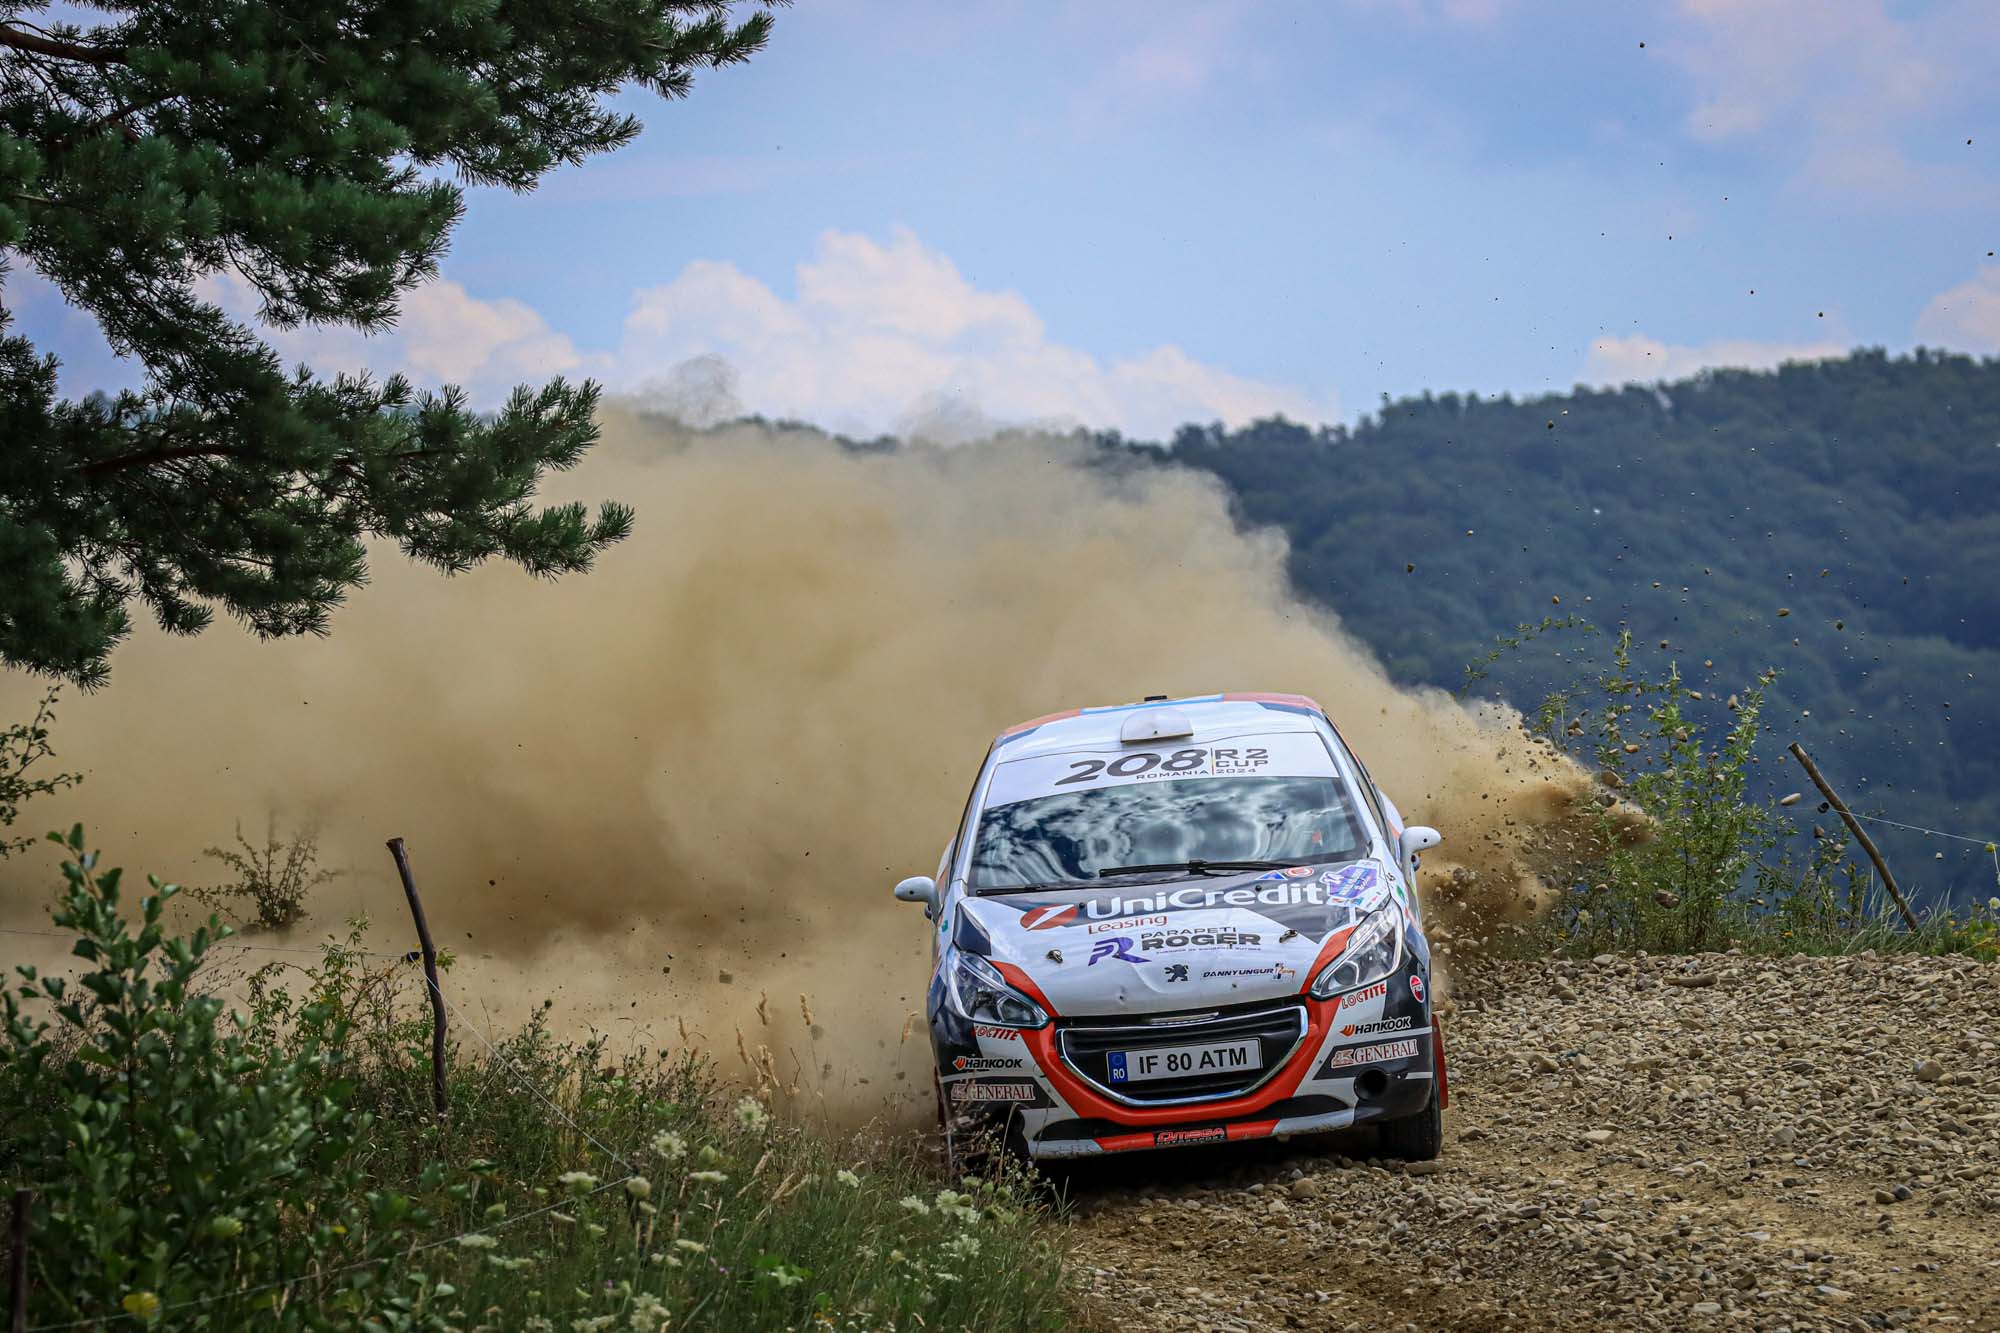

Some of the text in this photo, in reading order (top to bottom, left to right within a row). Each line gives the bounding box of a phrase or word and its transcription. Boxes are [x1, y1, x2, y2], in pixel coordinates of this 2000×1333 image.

[1054, 748, 1269, 786] 208 R2
[1215, 760, 1269, 768] CUP
[1136, 769, 1209, 780] ROMANIA
[1086, 882, 1323, 920] UniCredit
[1088, 915, 1168, 935] Leasing
[1141, 926, 1237, 939] PARAPETI
[1141, 933, 1262, 951] ROGER
[1342, 983, 1386, 1009] LOCTITE
[1139, 1047, 1247, 1074] IF 80 ATM
[1354, 1040, 1418, 1063] GENERALI
[1113, 1067, 1125, 1079] RO
[968, 1085, 1034, 1099] ENERALI
